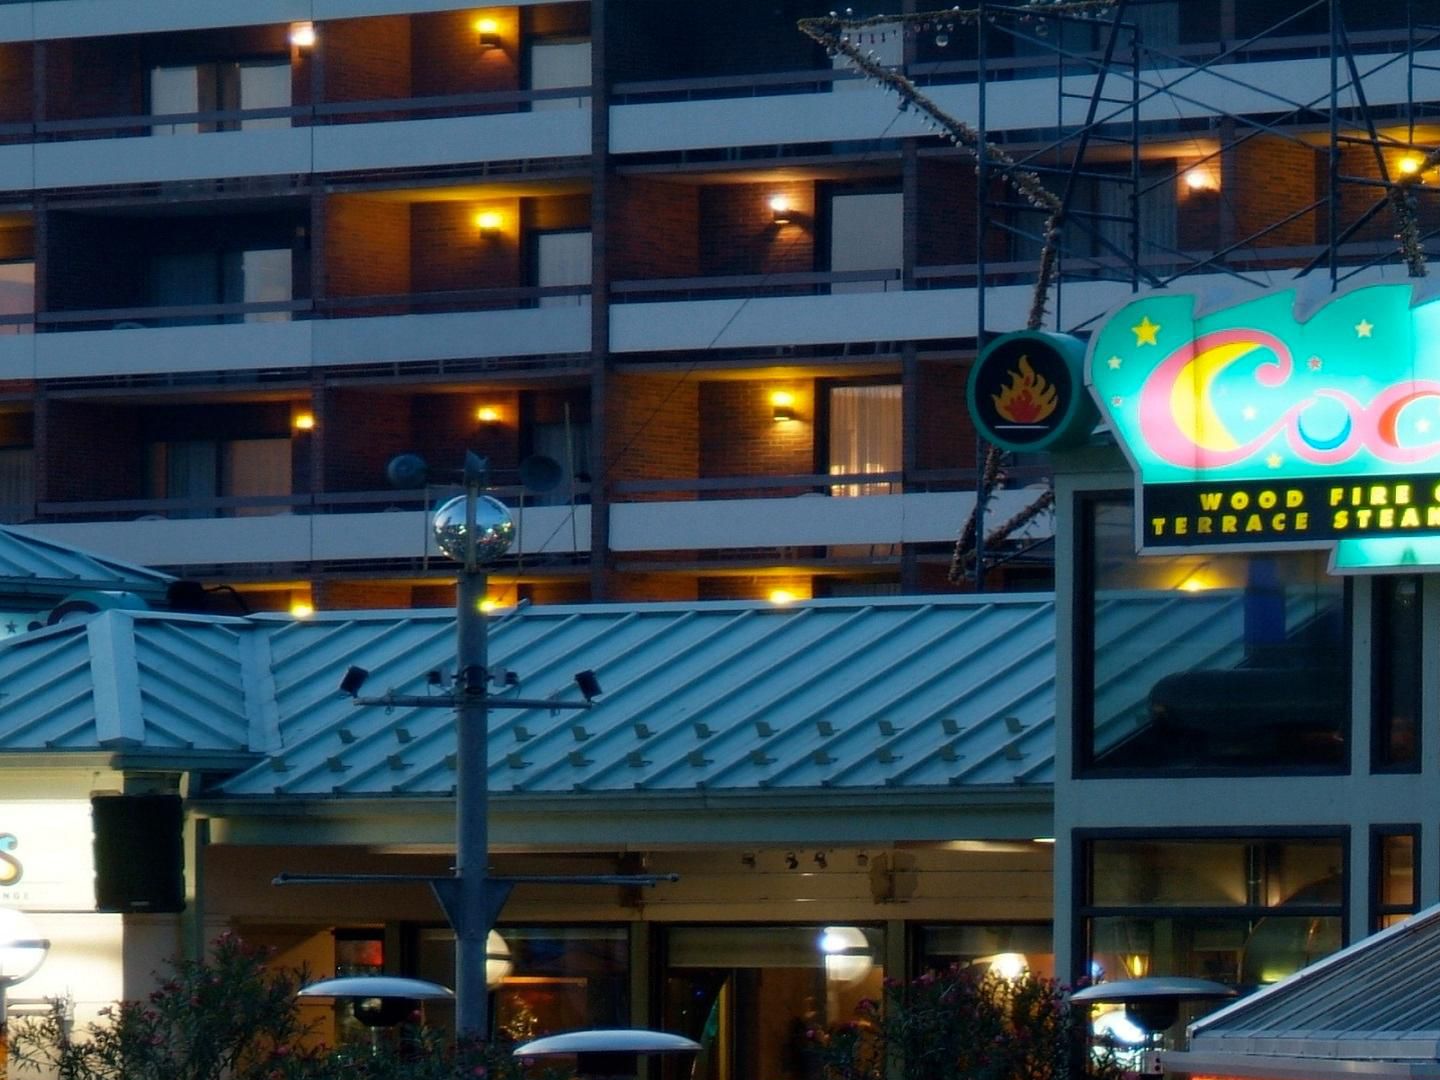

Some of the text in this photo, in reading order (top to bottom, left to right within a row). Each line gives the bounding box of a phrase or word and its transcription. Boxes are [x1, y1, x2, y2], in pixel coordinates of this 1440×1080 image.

[1200, 490, 1304, 511] WOOD
[1330, 485, 1411, 506] FIRE
[1152, 512, 1308, 535] TERRACE
